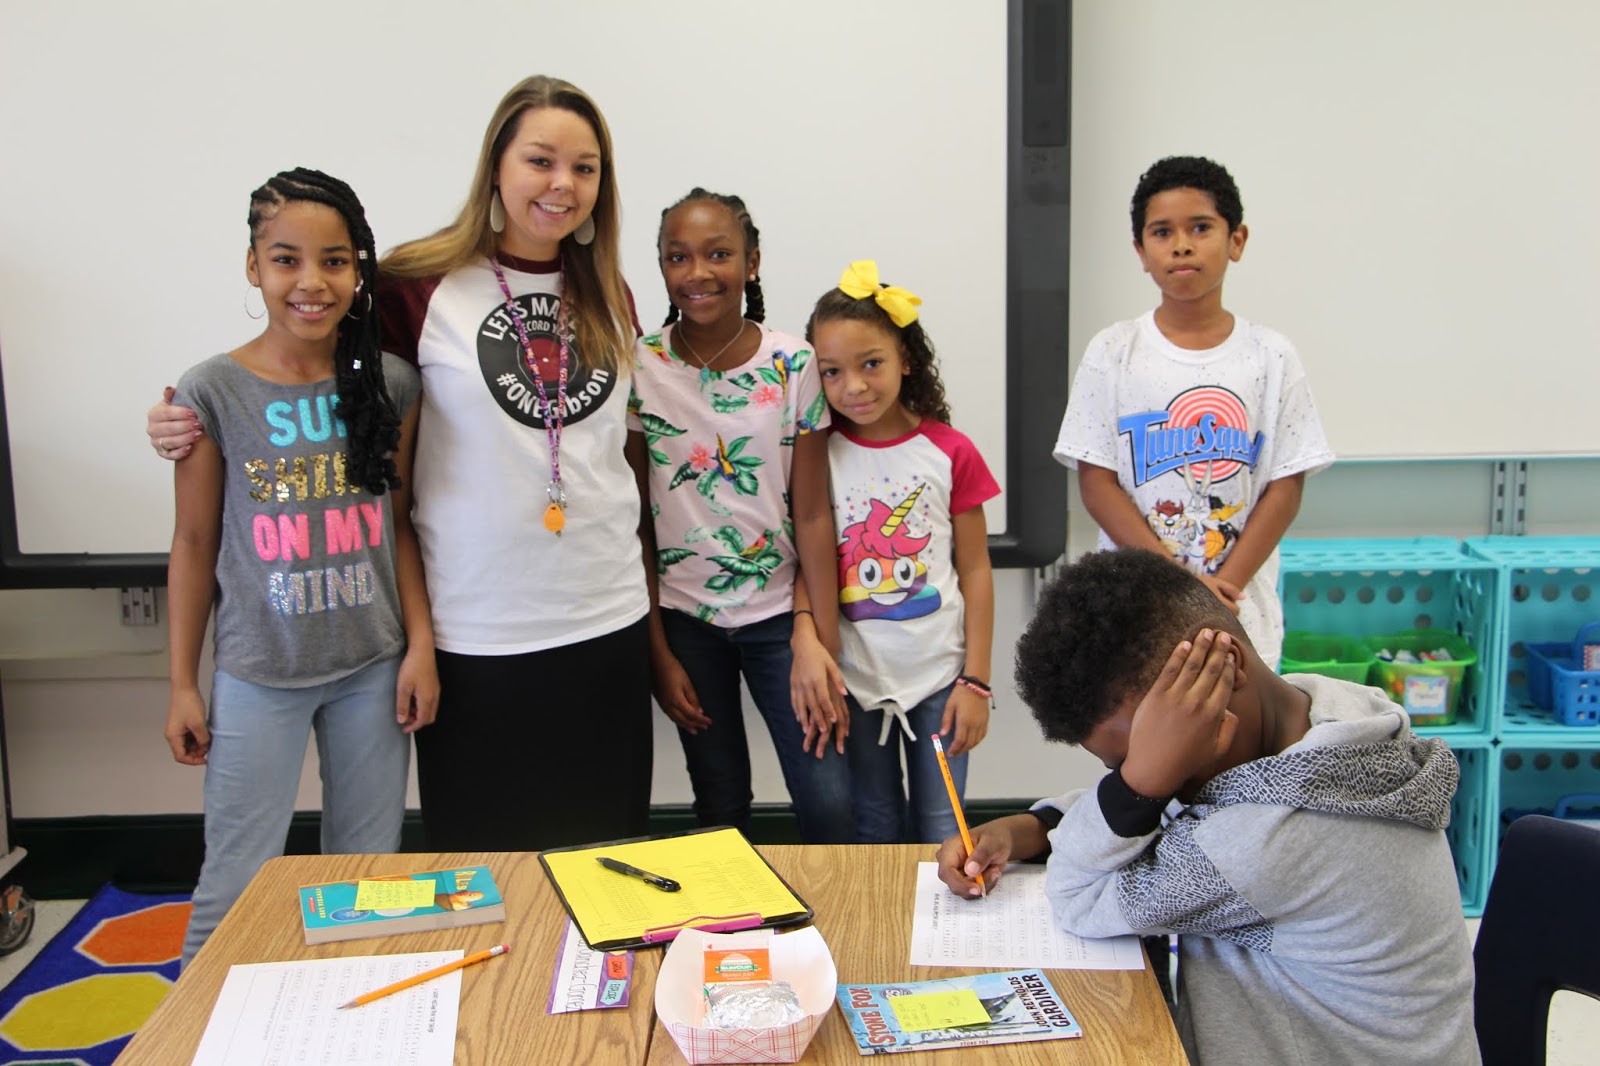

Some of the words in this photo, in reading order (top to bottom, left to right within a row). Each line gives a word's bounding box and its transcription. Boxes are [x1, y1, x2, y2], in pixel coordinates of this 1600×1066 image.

[482, 301, 528, 341] LETS
[531, 297, 561, 321] MA
[521, 320, 550, 334] ECORD
[1118, 409, 1266, 489] TuneSqud
[244, 452, 360, 502] SHI
[252, 512, 310, 561] ON
[324, 501, 382, 555] MY
[269, 560, 376, 616] MIND
[848, 987, 880, 1009] FOX
[1007, 976, 1037, 1010] REYNOLDS
[1021, 973, 1071, 1028] GARDINER
[859, 1010, 897, 1045] STONE
[1029, 1011, 1051, 1028] JOHN
